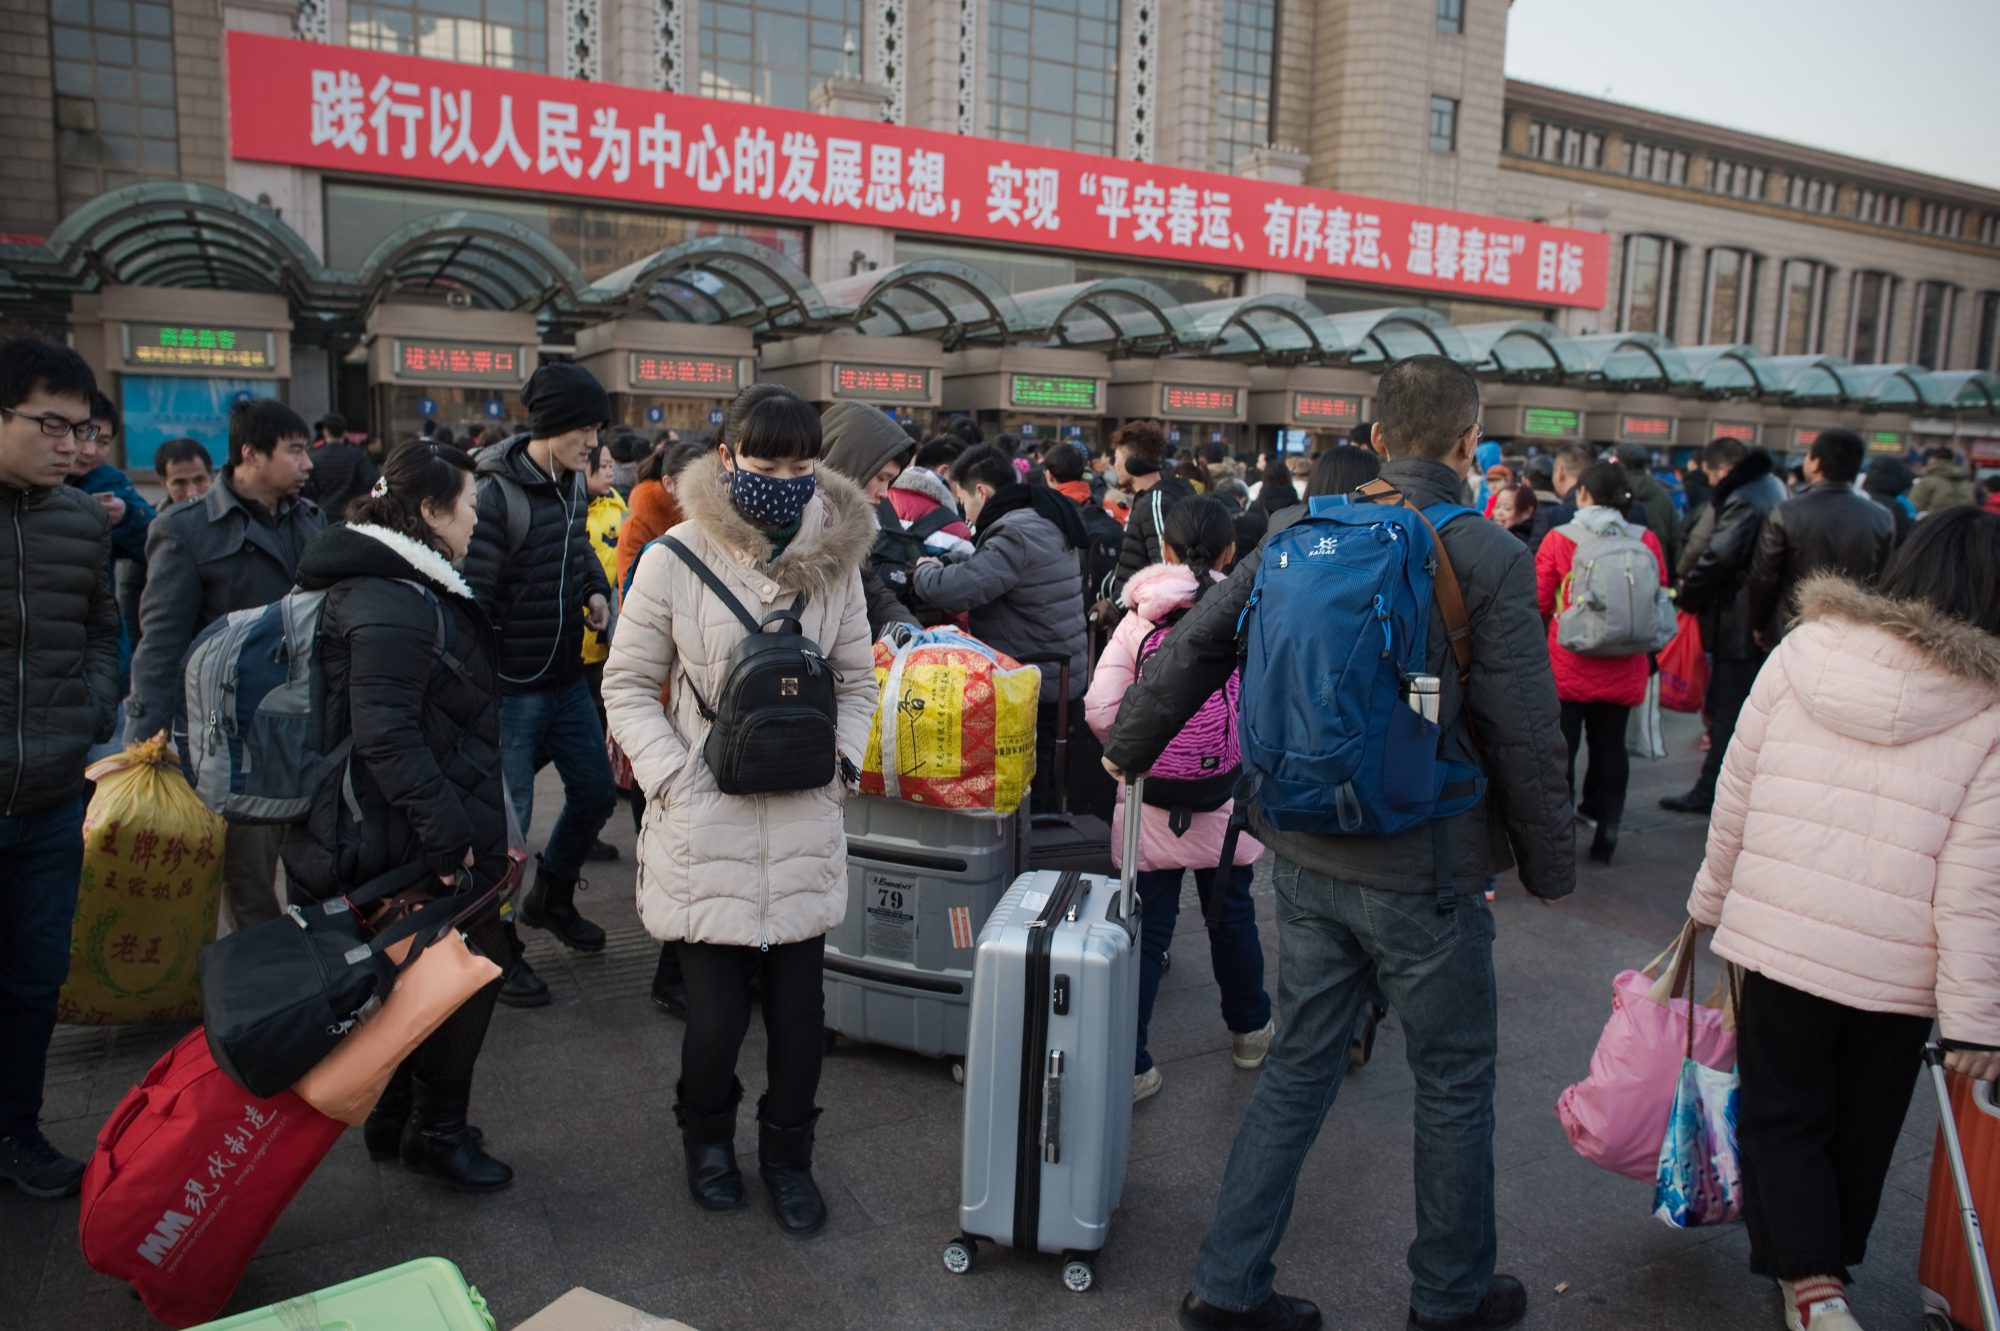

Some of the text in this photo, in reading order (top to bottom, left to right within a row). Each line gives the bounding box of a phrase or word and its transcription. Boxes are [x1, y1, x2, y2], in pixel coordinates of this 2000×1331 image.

[406, 347, 513, 373] 进站验票口
[639, 359, 733, 383] 进站验票口
[840, 369, 923, 391] 进站验票口
[710, 413, 724, 424] 10
[878, 877, 912, 891] EMINENT
[878, 888, 904, 909] 79
[184, 1104, 278, 1217] 现代制造
